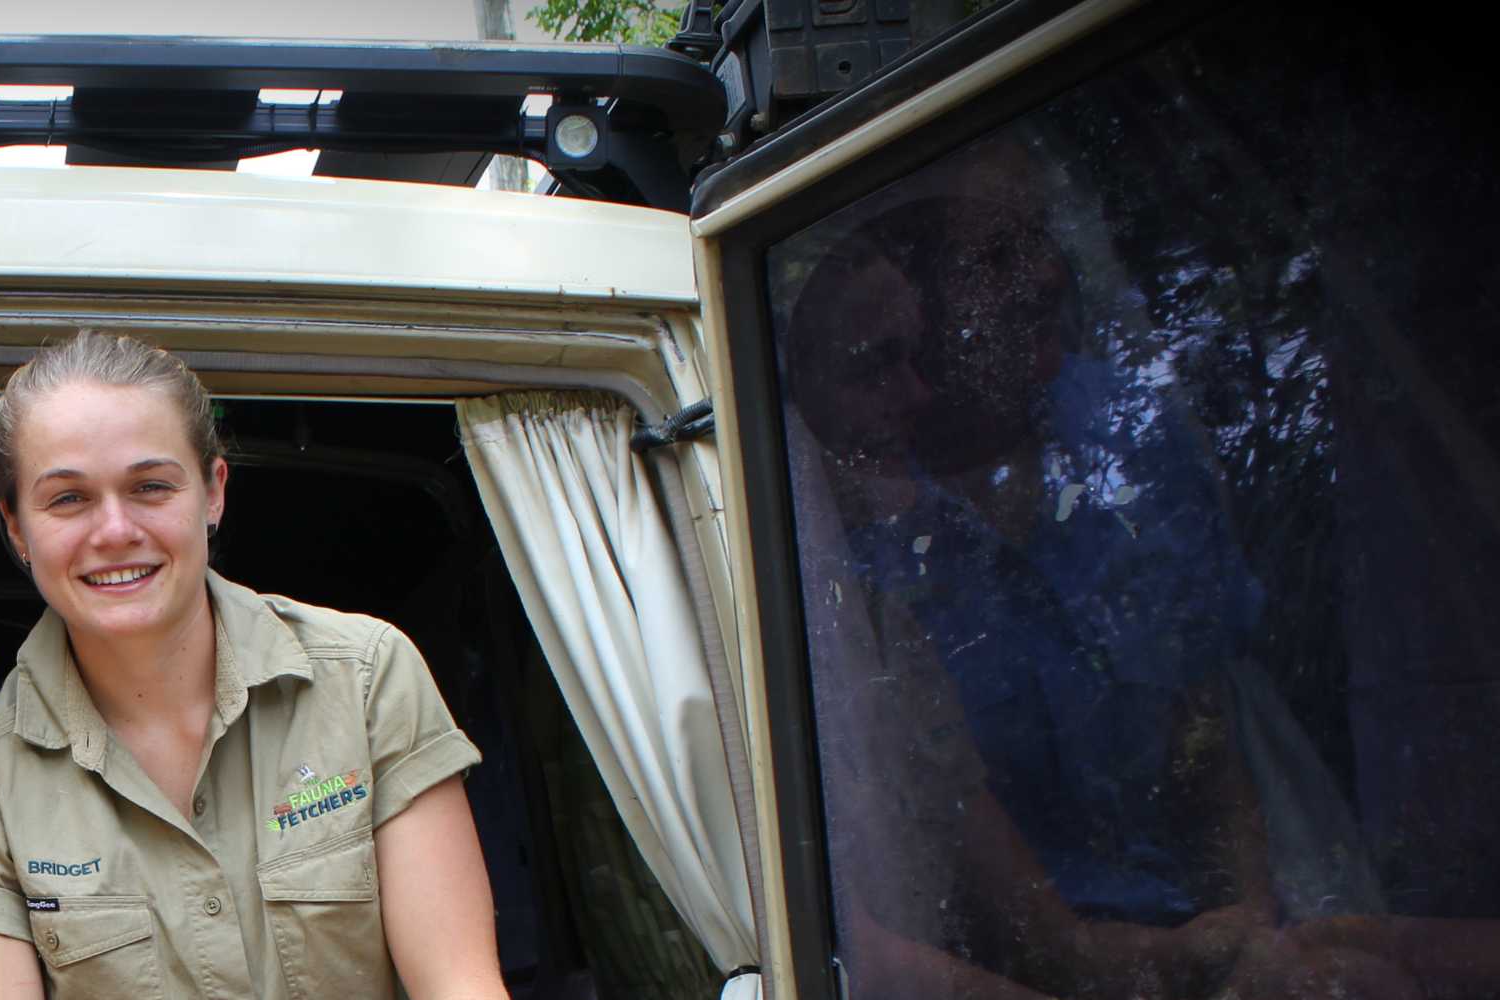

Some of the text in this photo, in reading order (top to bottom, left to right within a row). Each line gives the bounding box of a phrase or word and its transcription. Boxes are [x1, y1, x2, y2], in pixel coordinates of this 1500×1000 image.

[277, 785, 368, 830] FETCHERS
[288, 775, 347, 809] FAUNA
[27, 858, 102, 876] BRIDGET
